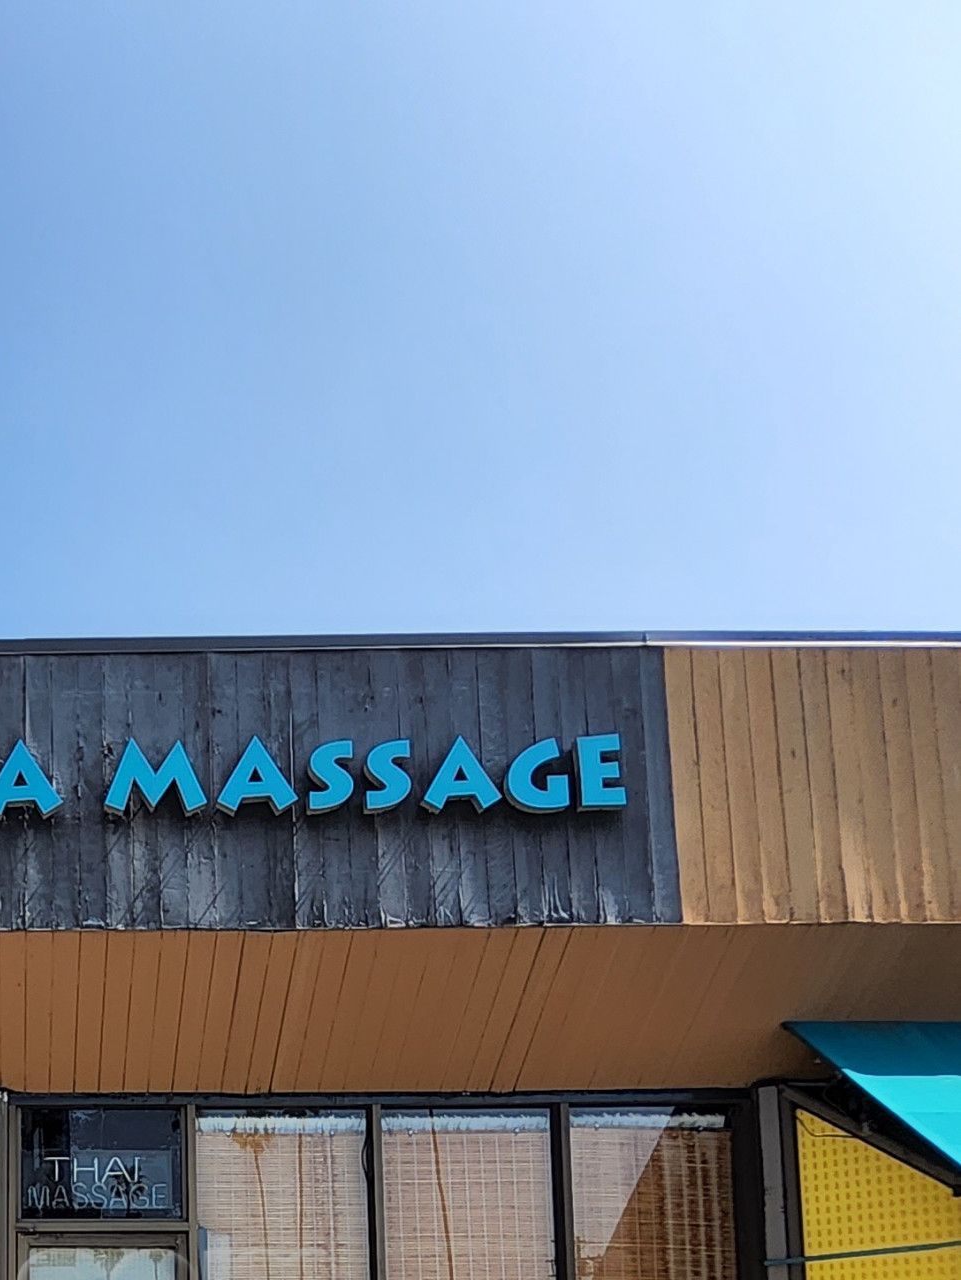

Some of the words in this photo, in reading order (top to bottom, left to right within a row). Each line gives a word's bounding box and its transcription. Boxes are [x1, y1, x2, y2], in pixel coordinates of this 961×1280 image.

[103, 733, 627, 818] MASSAGE
[43, 1157, 144, 1184] THAI
[27, 1182, 168, 1210] MASSAGE
